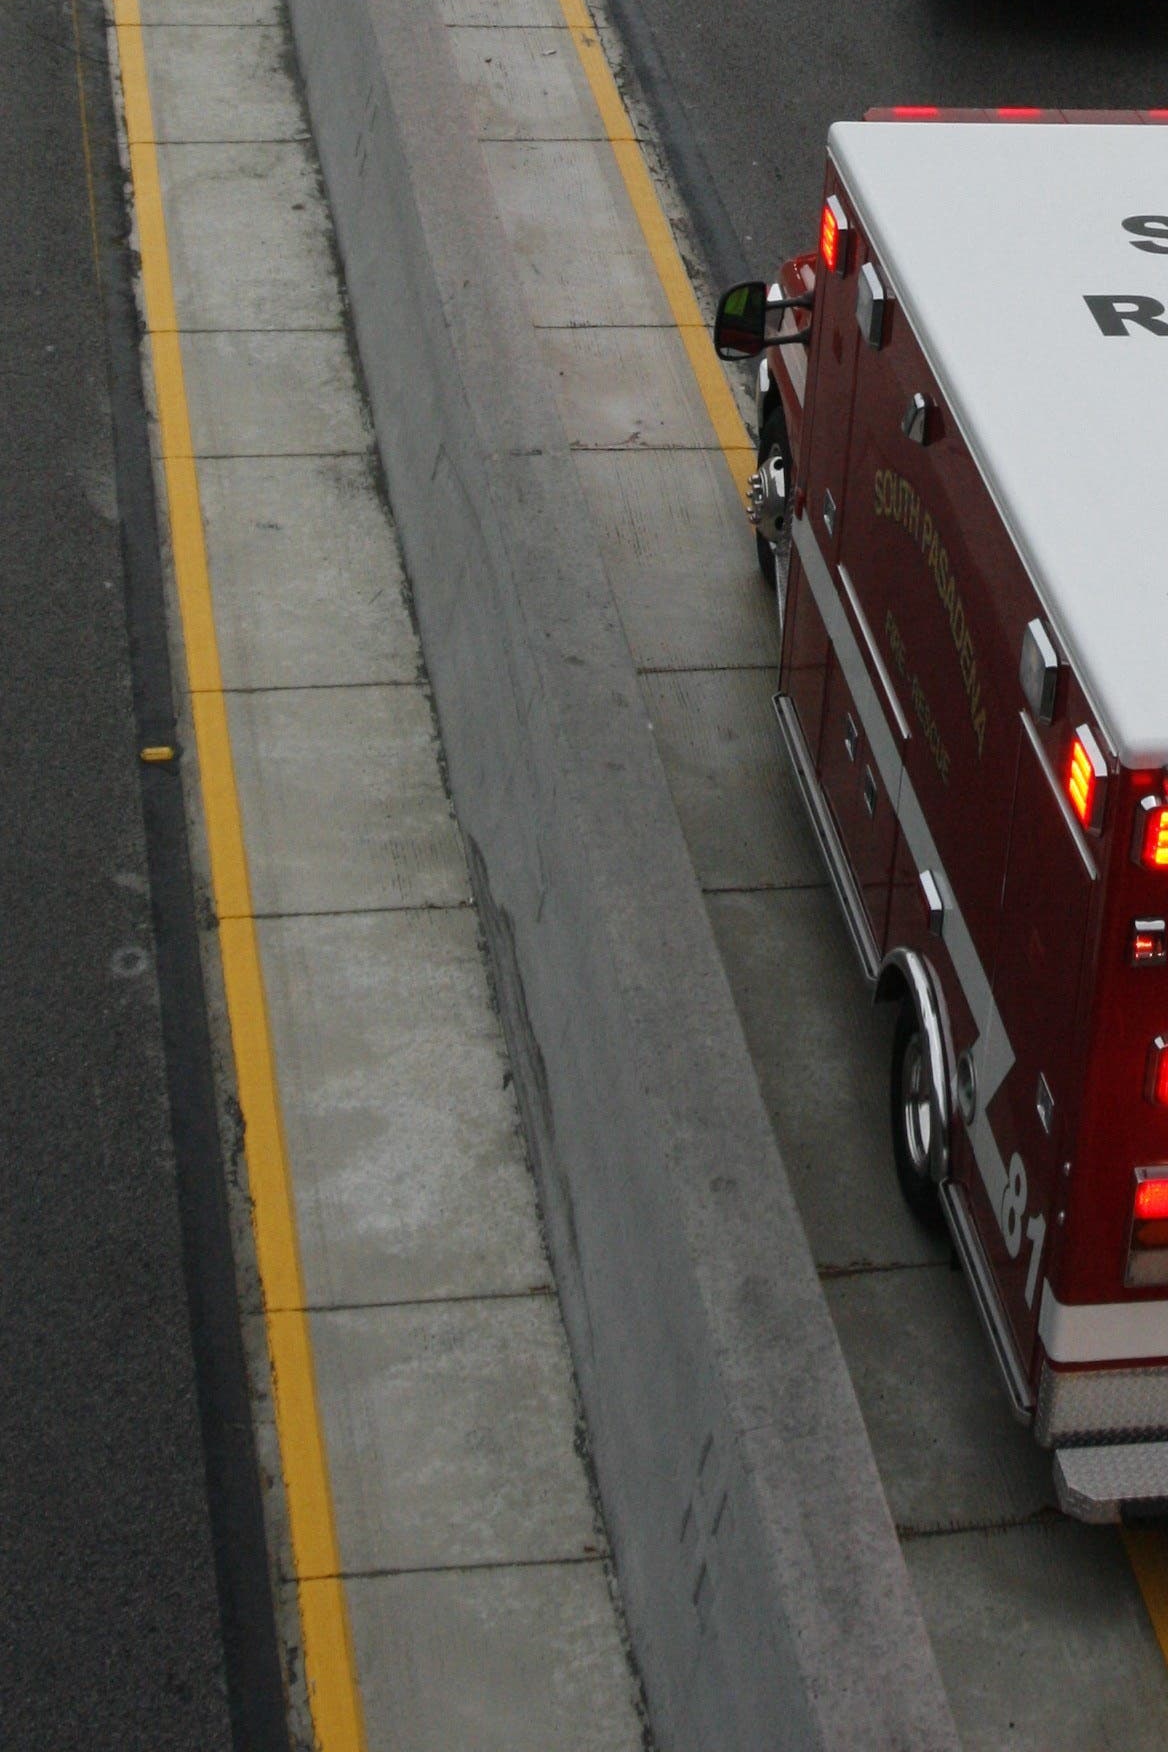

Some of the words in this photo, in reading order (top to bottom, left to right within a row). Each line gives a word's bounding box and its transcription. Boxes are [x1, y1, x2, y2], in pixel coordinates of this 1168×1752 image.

[874, 469, 921, 542] SOUTH
[921, 512, 986, 761] PASADENA
[1001, 1151, 1047, 1313] 81
